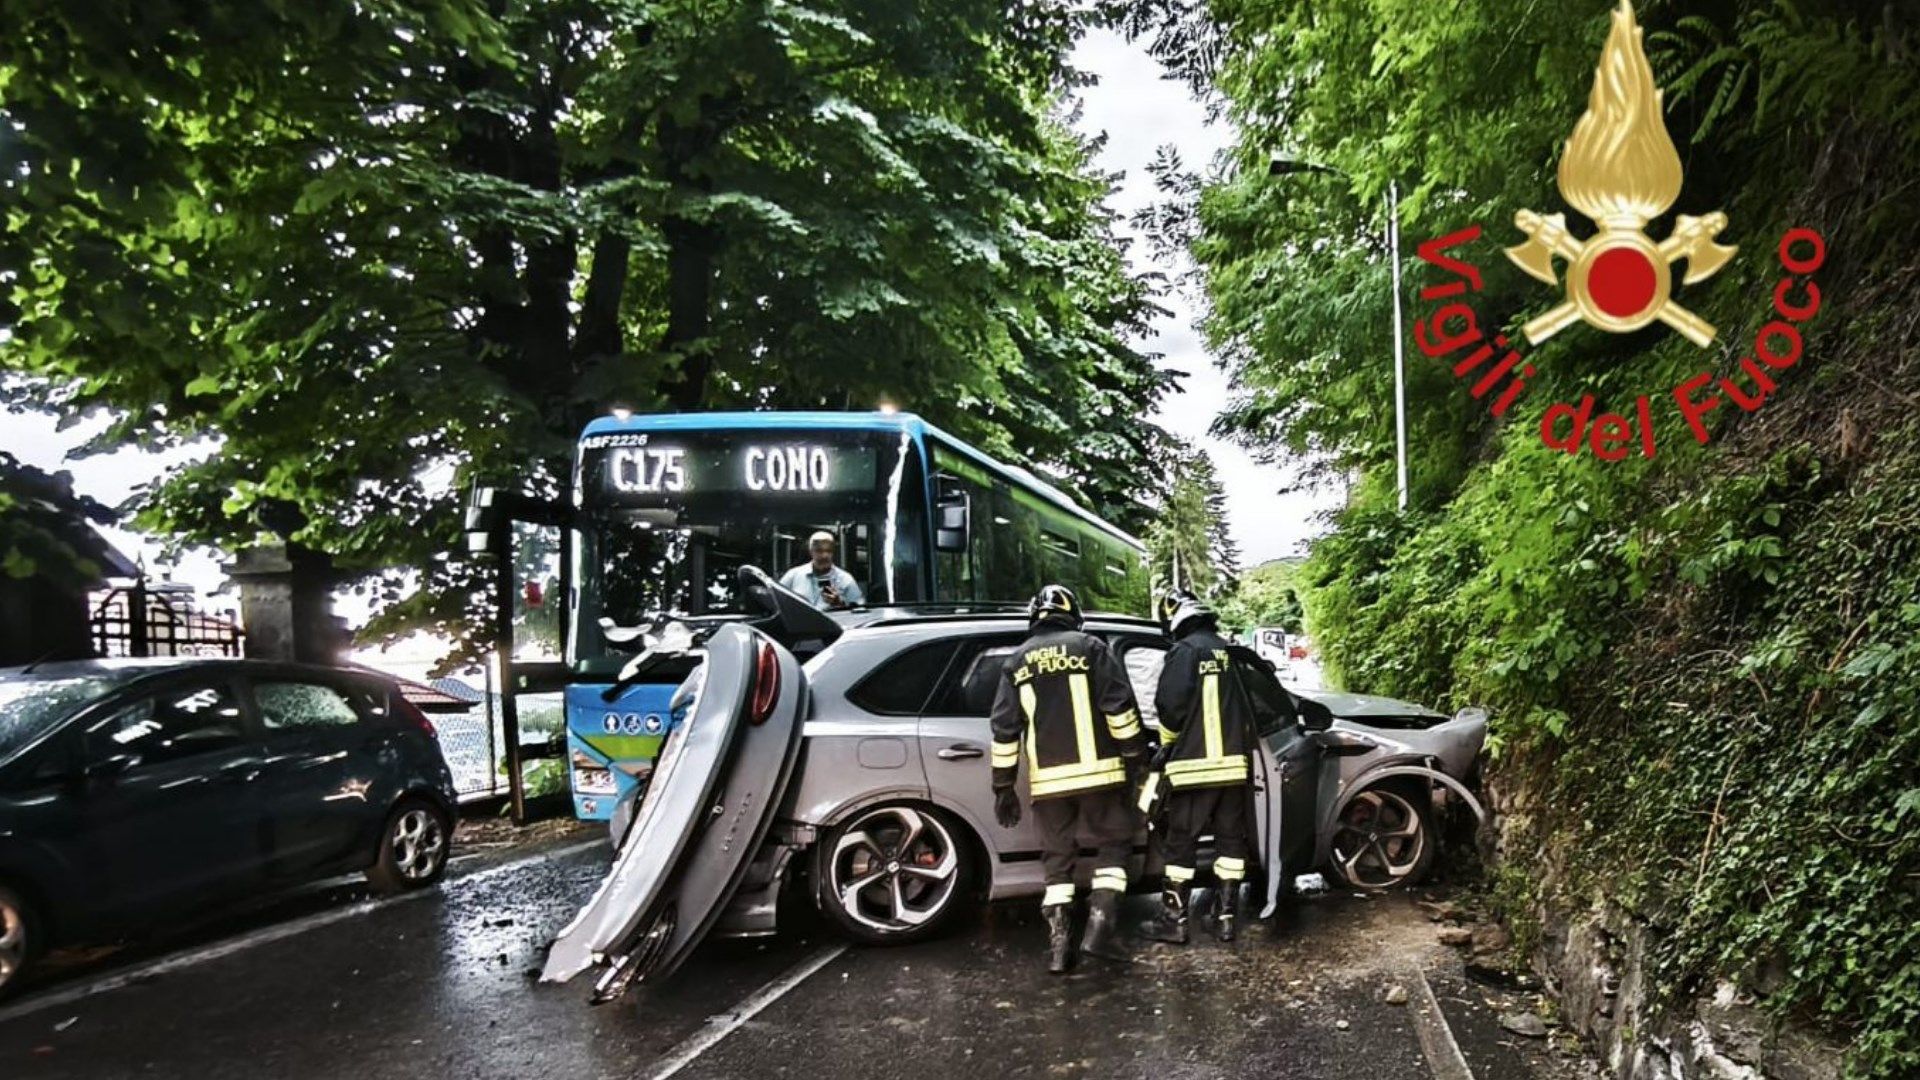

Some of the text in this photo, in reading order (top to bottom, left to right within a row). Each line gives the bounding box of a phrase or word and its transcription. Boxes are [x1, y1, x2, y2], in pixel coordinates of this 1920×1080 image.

[583, 434, 648, 449] ASF2226
[612, 447, 829, 492] C175 COMO
[1024, 644, 1067, 664] VIGILI
[1199, 660, 1221, 674] DEL
